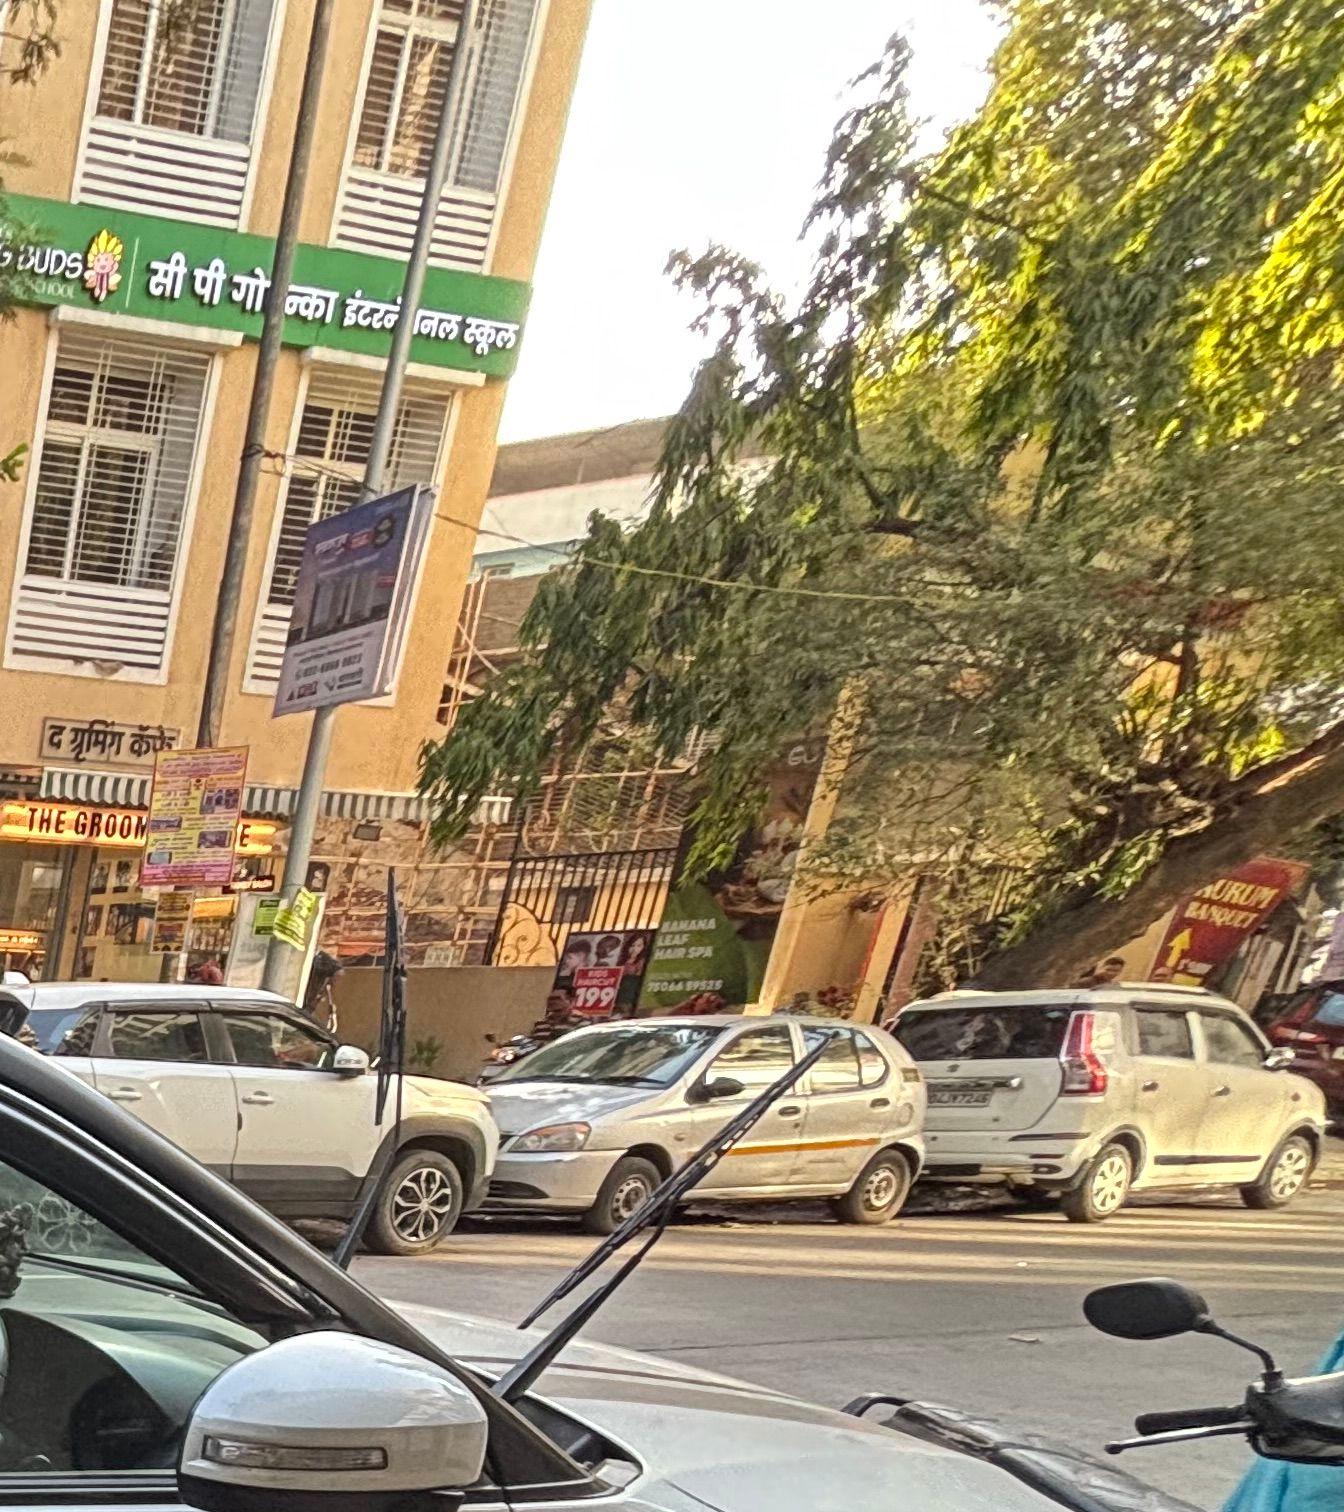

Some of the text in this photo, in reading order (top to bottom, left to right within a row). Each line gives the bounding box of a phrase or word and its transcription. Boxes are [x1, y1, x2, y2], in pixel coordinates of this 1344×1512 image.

[148, 252, 187, 299] सी
[193, 258, 227, 305] पी
[231, 267, 340, 325] गोन्का
[462, 316, 520, 355] स्कूल
[47, 724, 66, 750] द
[28, 807, 148, 841] THE GROOM
[656, 933, 691, 948] LEAF
[575, 986, 615, 1008] 199
